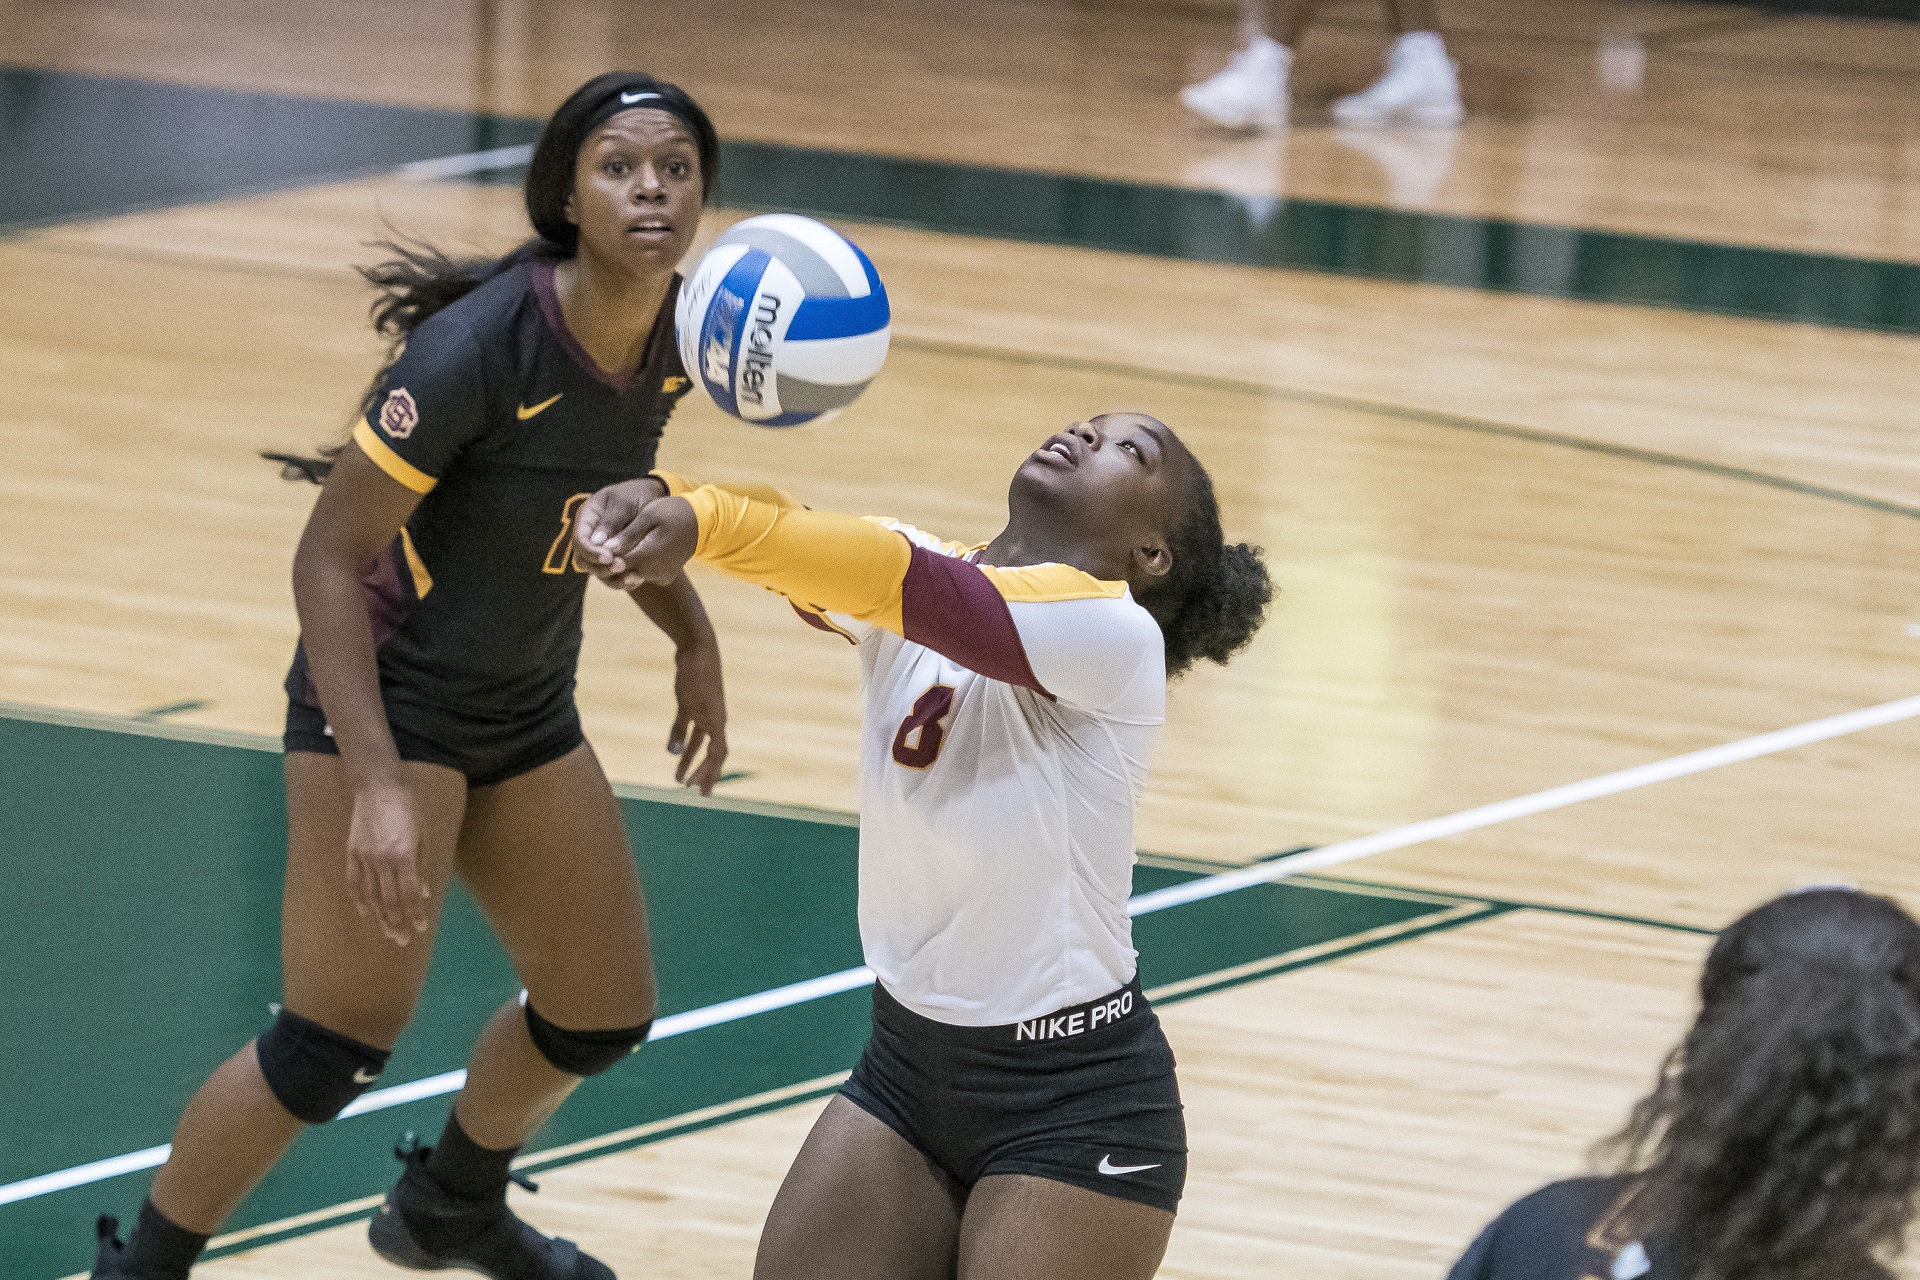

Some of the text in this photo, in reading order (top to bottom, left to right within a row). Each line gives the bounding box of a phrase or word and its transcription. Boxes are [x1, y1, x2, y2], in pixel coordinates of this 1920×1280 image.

[741, 291, 782, 406] molten
[891, 682, 957, 771] 8
[1016, 990, 1133, 1041] NIKE PRO
